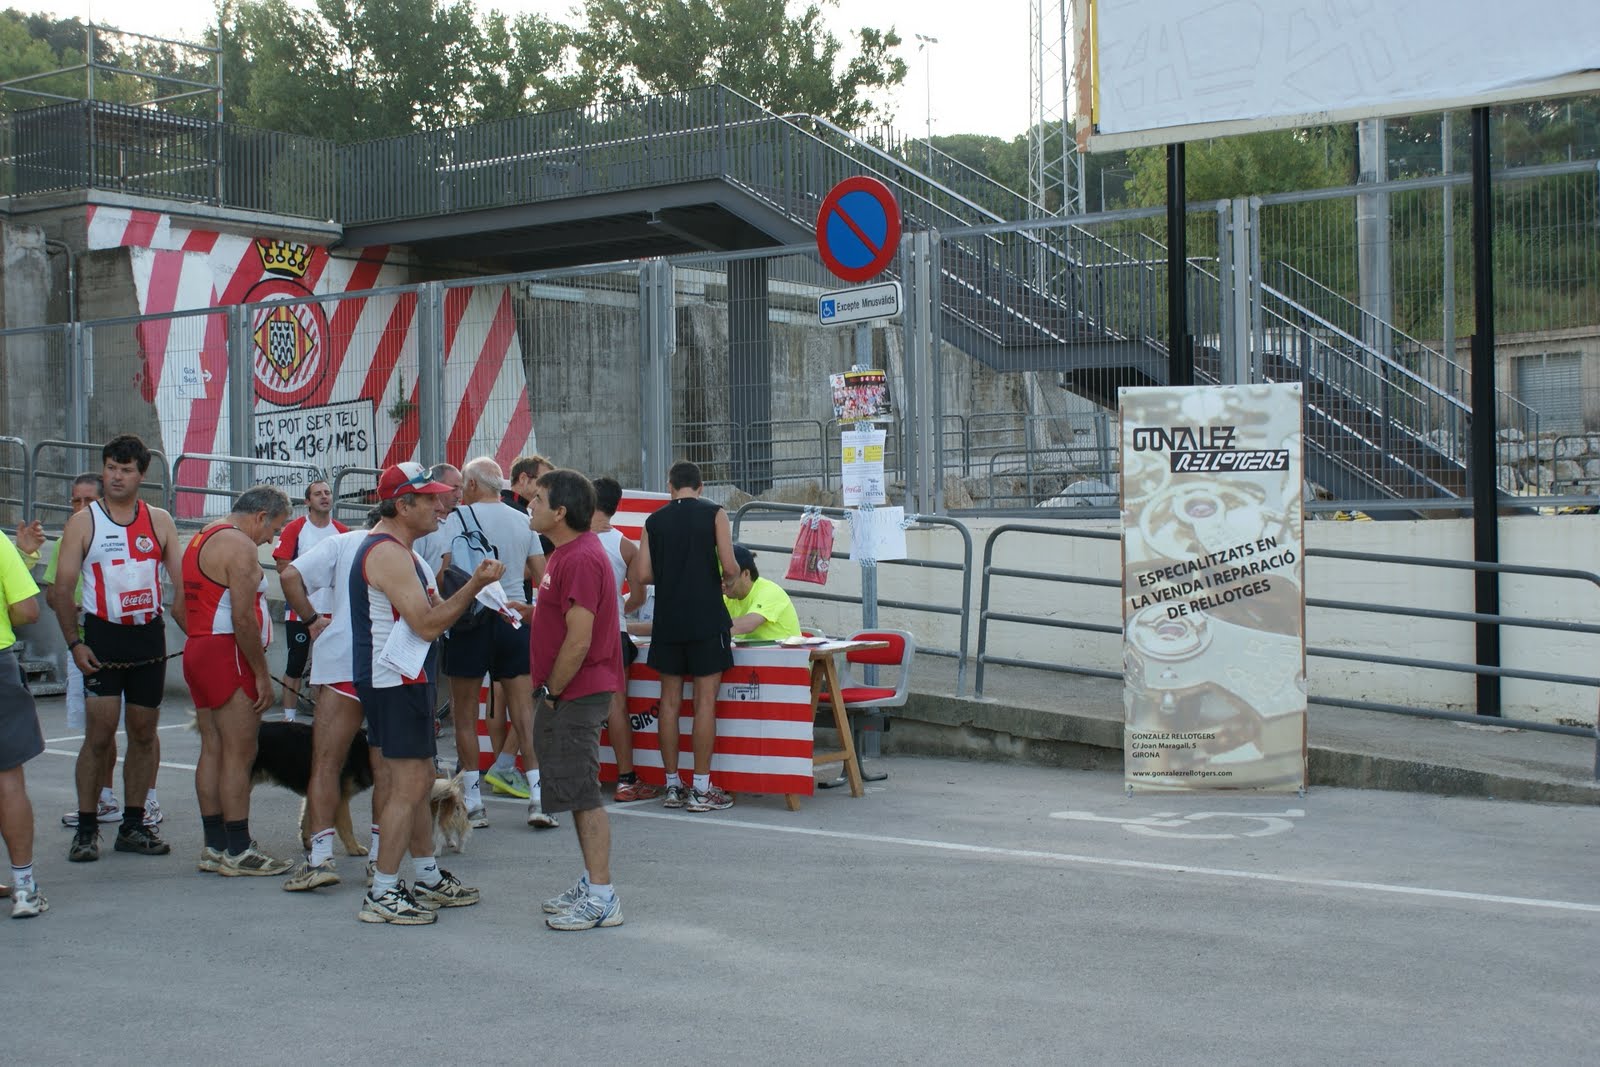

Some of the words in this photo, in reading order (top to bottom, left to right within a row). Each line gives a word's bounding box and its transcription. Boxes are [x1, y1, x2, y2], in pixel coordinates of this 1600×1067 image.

[837, 301, 860, 313] Excepte
[279, 417, 301, 434] POT
[306, 413, 332, 431] SER
[336, 410, 359, 427] TEU
[1133, 426, 1236, 451] GONZALEZ
[1174, 451, 1289, 472] RELLOTGERS
[1138, 542, 1254, 587] ESPECIALITZATS
[1256, 536, 1277, 553] EN
[1131, 594, 1151, 610] LA
[1152, 579, 1203, 603] VENDA
[1205, 576, 1212, 588] I
[1214, 549, 1296, 586] REPARACIÓ
[122, 593, 152, 607] Coca-Cola
[1167, 603, 1188, 619] DE
[1190, 579, 1271, 613] RELLOTGES
[630, 702, 661, 731] GIRO
[1132, 770, 1233, 778] www.gonzalezrellotgers.com
